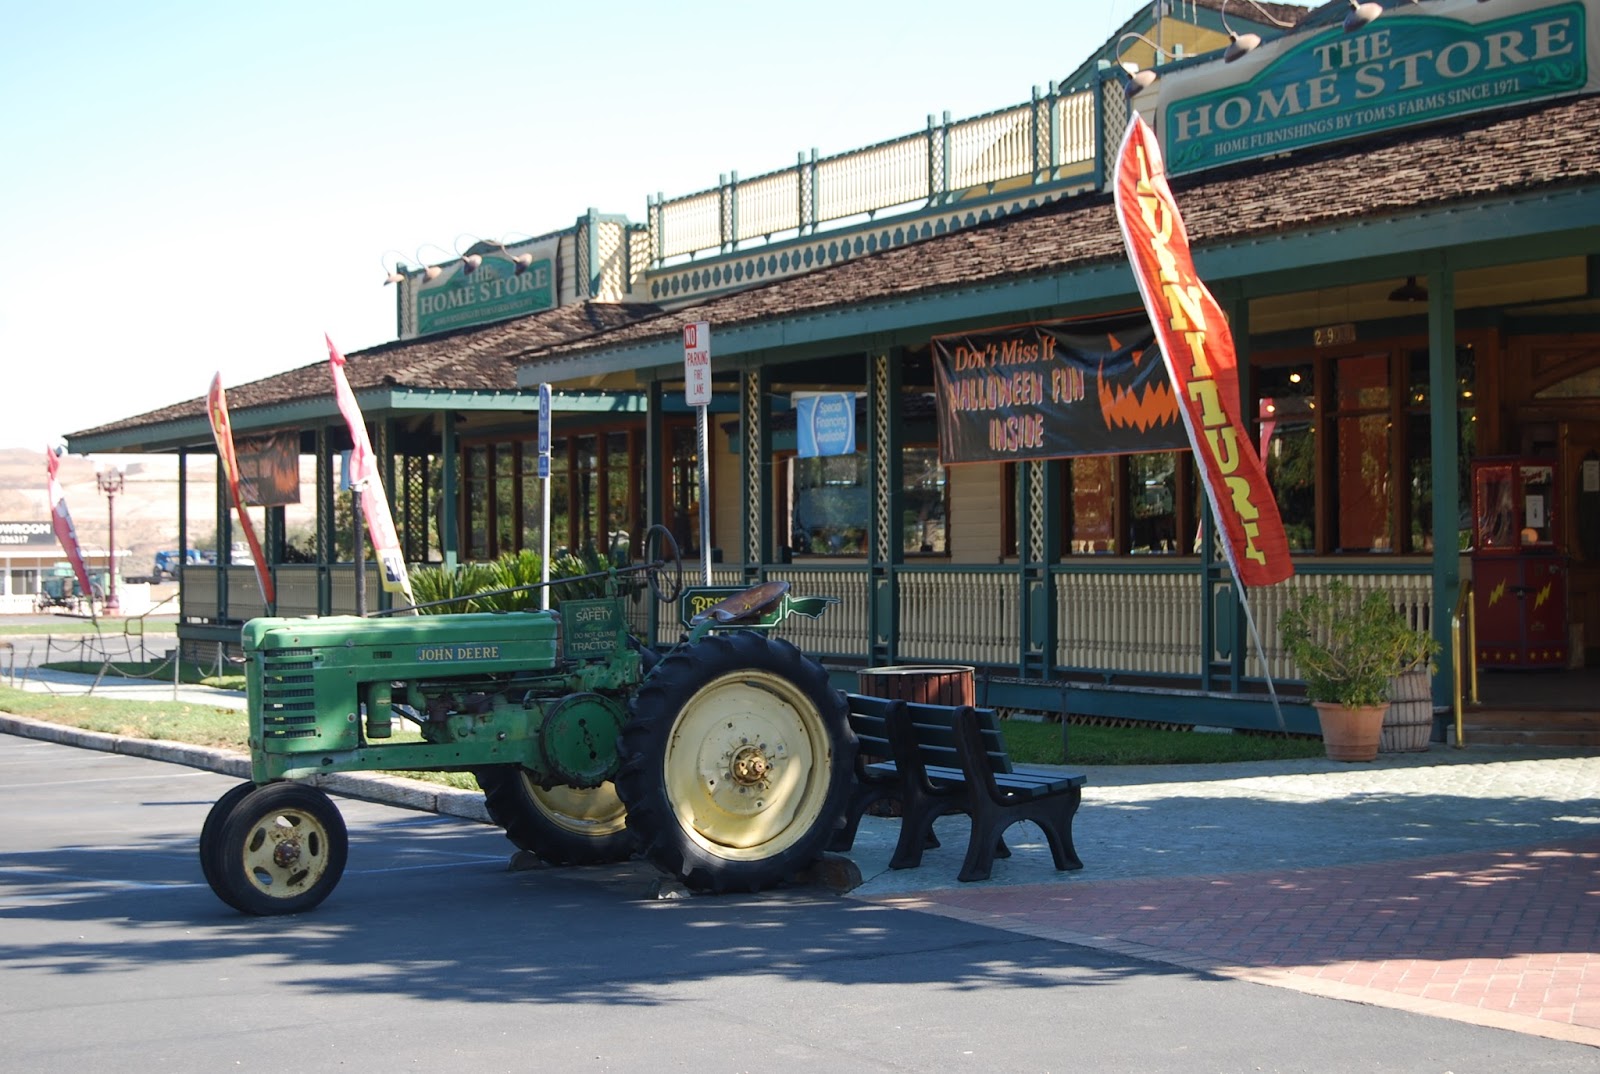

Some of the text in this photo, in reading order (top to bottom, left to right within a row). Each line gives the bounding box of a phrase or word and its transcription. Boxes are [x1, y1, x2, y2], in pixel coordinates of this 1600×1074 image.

[1313, 29, 1393, 73] THE
[1174, 18, 1575, 142] HOME STORE
[1214, 78, 1520, 156] HOME FURNISHINGS BY TOM'S FARMS SINCE 1971
[420, 287, 477, 316] HOME
[480, 267, 548, 298] STORE
[685, 327, 696, 346] NO
[687, 351, 708, 367] PARKING
[955, 334, 1057, 372] Don't Miss It
[693, 369, 703, 381] FIRE
[693, 383, 705, 396] LANE
[949, 366, 1084, 413] HALLOWEEN FUN
[819, 402, 842, 416] Special
[816, 414, 847, 430] Financing
[989, 412, 1044, 451] INSIDE
[576, 610, 613, 622] SAFETY
[418, 647, 499, 661] JOHN DEERE
